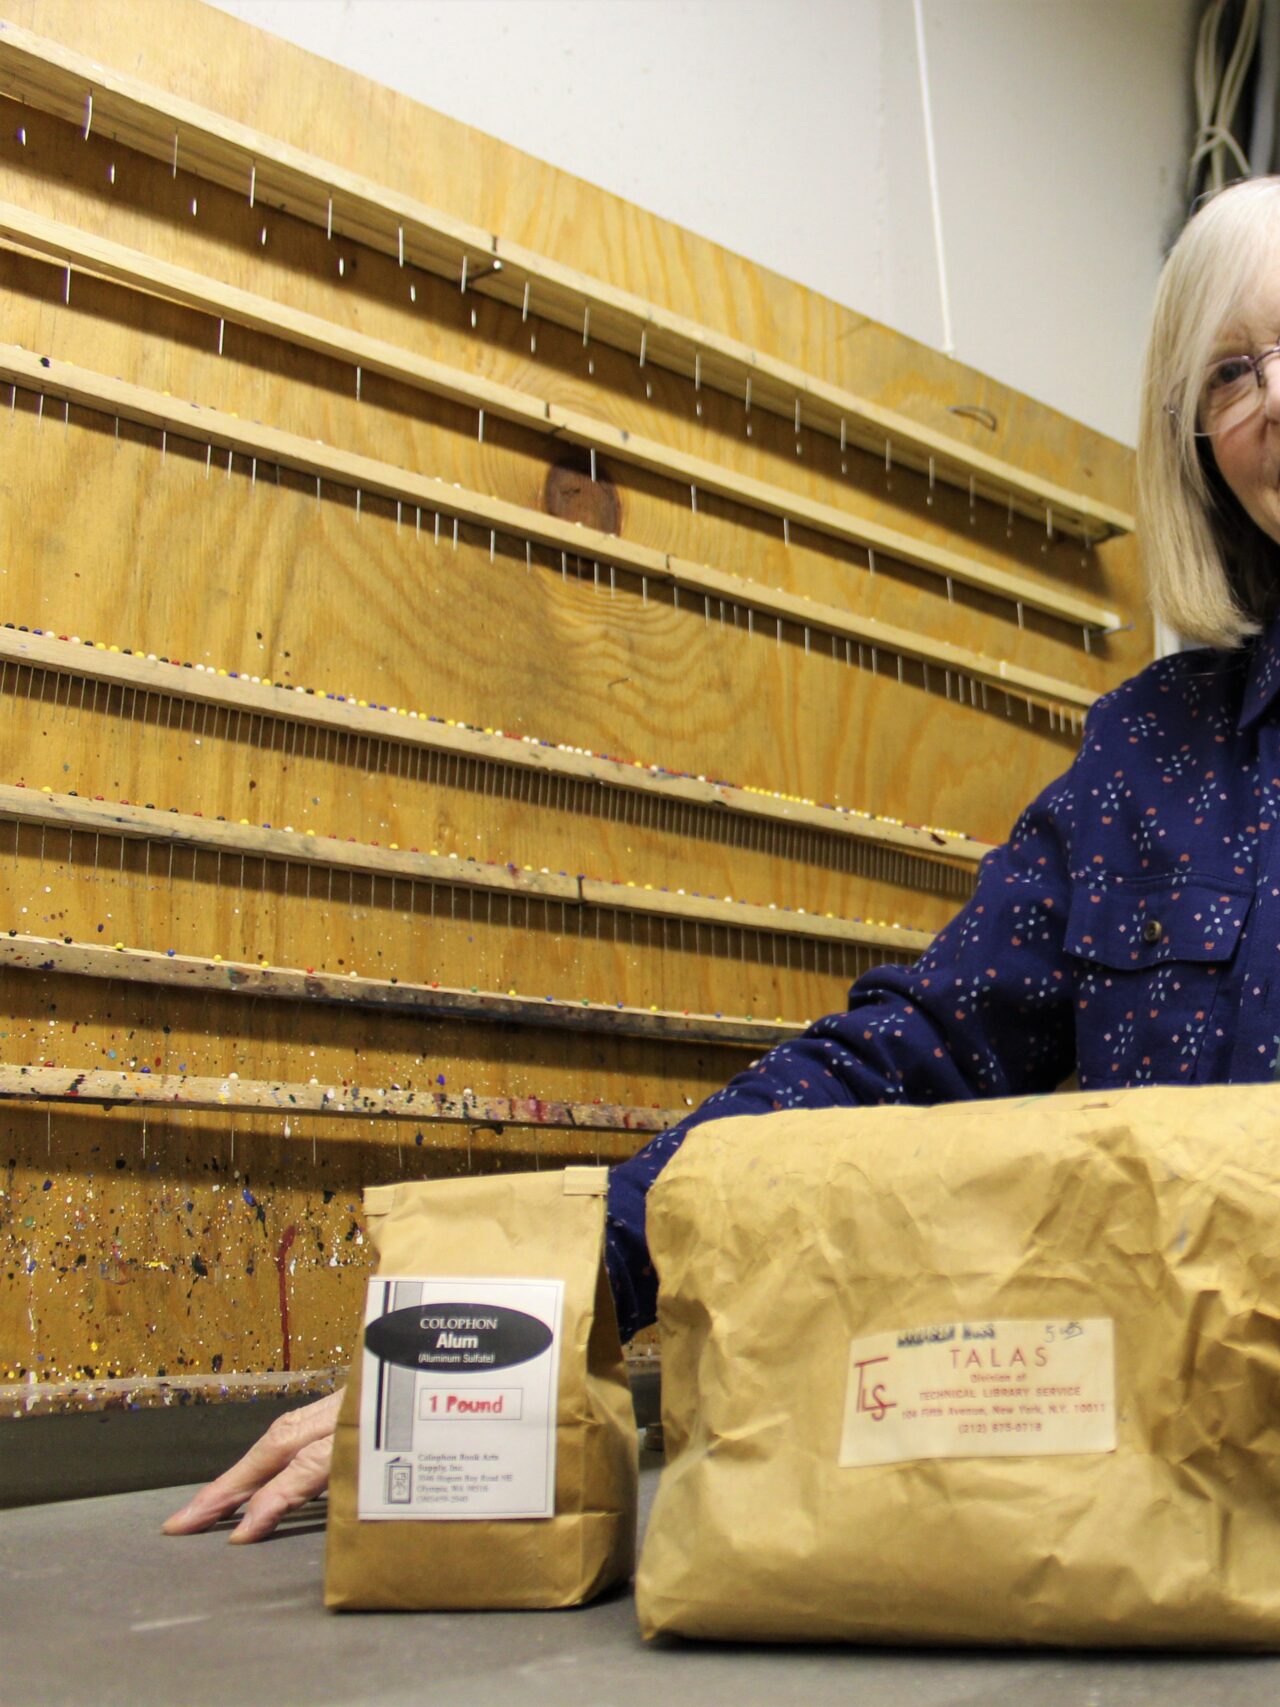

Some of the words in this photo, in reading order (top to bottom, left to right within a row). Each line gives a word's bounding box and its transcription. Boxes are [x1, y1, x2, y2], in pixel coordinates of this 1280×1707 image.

[419, 1317, 498, 1330] COLOPHON
[435, 1333, 479, 1349] Alum
[418, 1353, 461, 1364] (Aluminum
[462, 1352, 495, 1363] Sulfate)
[950, 1346, 1049, 1369] TALAS
[919, 1389, 977, 1400] TECHNICAL
[982, 1387, 1029, 1398] LIBRARY
[1035, 1386, 1081, 1397] SERVICE
[430, 1395, 438, 1413] 1
[446, 1395, 504, 1414] Pound
[991, 1405, 1014, 1415] New
